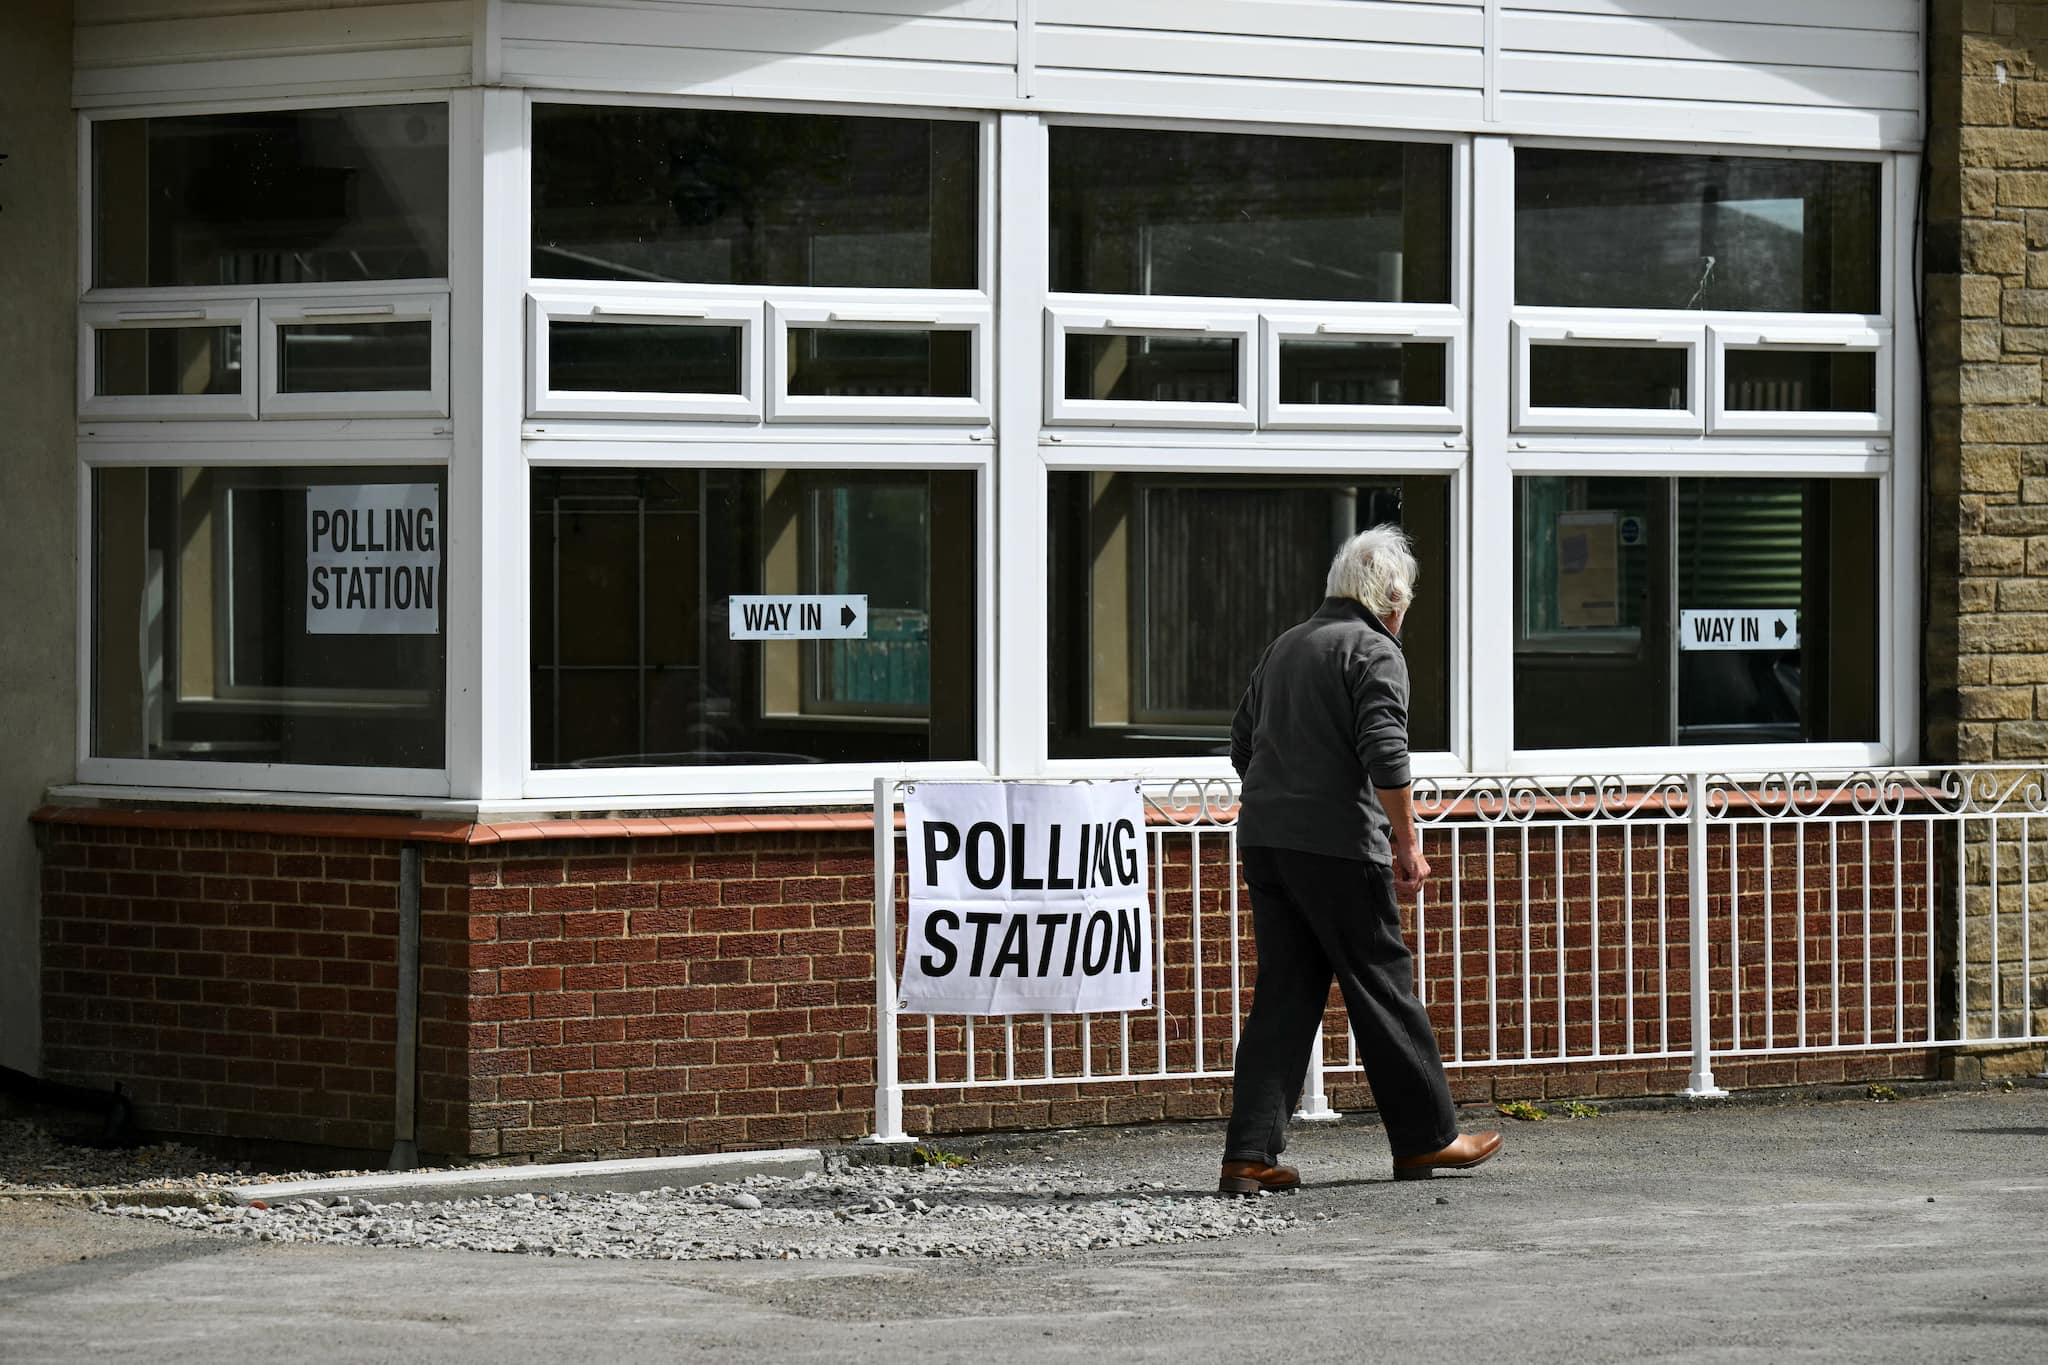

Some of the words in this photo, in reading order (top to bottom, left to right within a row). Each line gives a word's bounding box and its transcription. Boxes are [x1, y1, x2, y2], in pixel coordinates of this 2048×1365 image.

[312, 507, 435, 553] POLLING
[311, 566, 434, 610] STATION
[743, 603, 792, 631] WAY
[800, 603, 821, 631] IN
[1694, 617, 1734, 642] WAY
[1741, 617, 1759, 642] IN
[922, 818, 1139, 890] POLLING
[920, 907, 1141, 978] STATION
